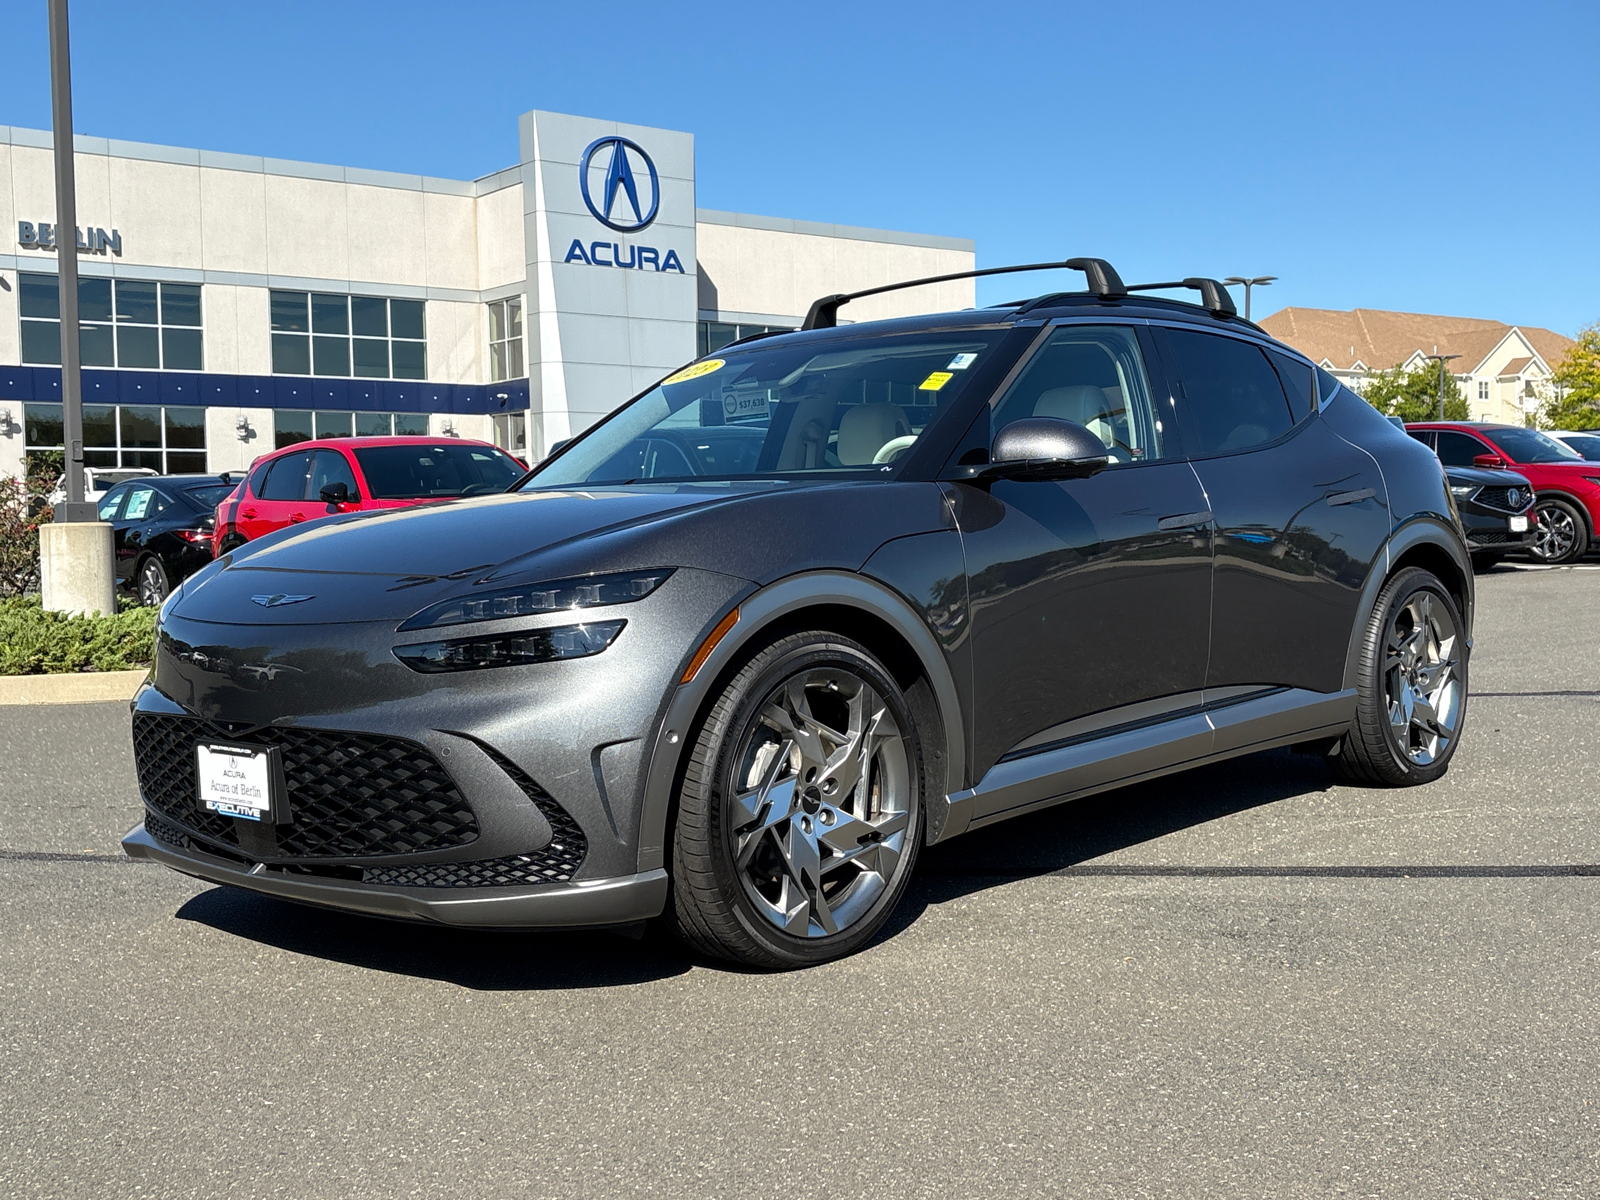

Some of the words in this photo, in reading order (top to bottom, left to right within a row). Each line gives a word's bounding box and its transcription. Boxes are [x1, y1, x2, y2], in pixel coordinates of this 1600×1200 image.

[18, 221, 120, 252] BELIN
[564, 239, 685, 274] ACURA
[739, 398, 765, 410] $37,638
[223, 769, 246, 779] ACURA
[211, 779, 230, 793] Acura
[231, 784, 239, 795] of
[240, 784, 261, 798] Berlin
[206, 801, 260, 817] EXECUTIVE
